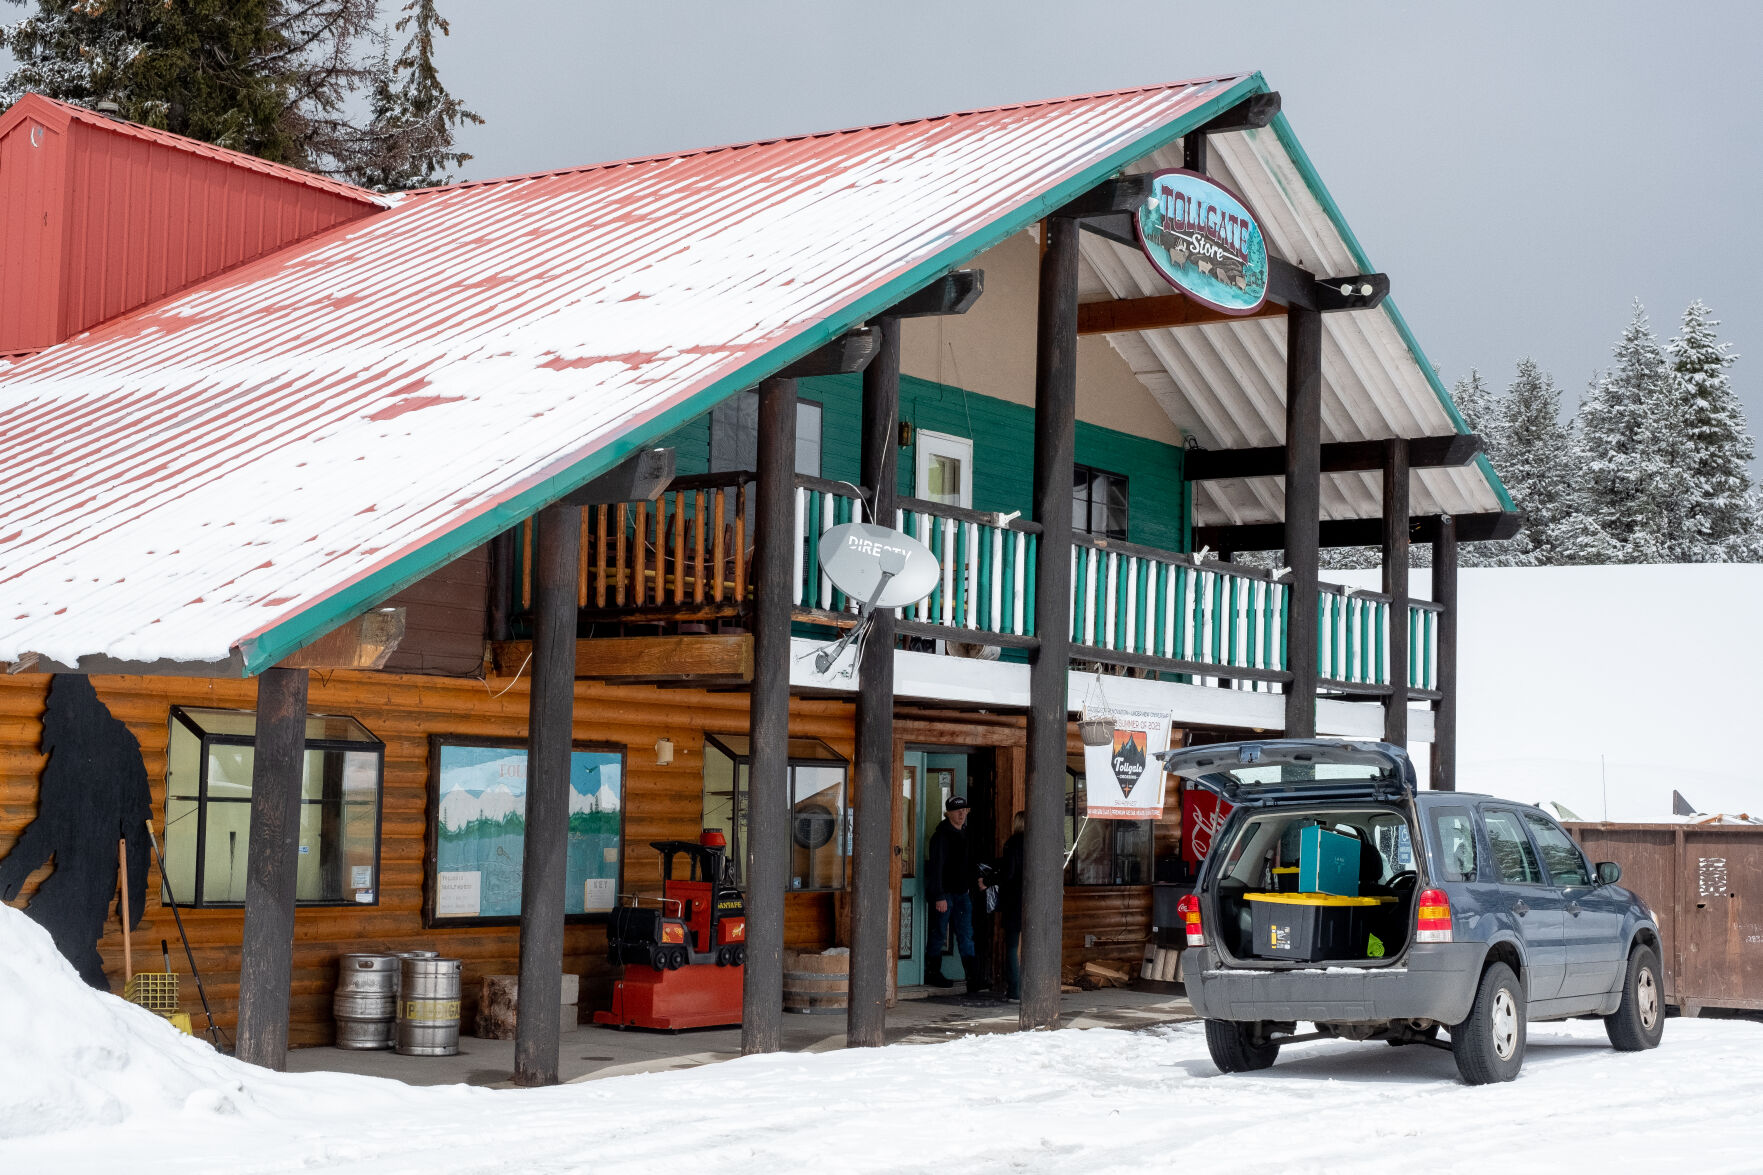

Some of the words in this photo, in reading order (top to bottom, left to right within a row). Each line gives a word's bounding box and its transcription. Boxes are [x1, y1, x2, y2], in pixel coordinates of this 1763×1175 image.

[1161, 184, 1250, 265] TOLLGATE
[1189, 233, 1224, 261] Store
[1114, 757, 1143, 774] Tollgate
